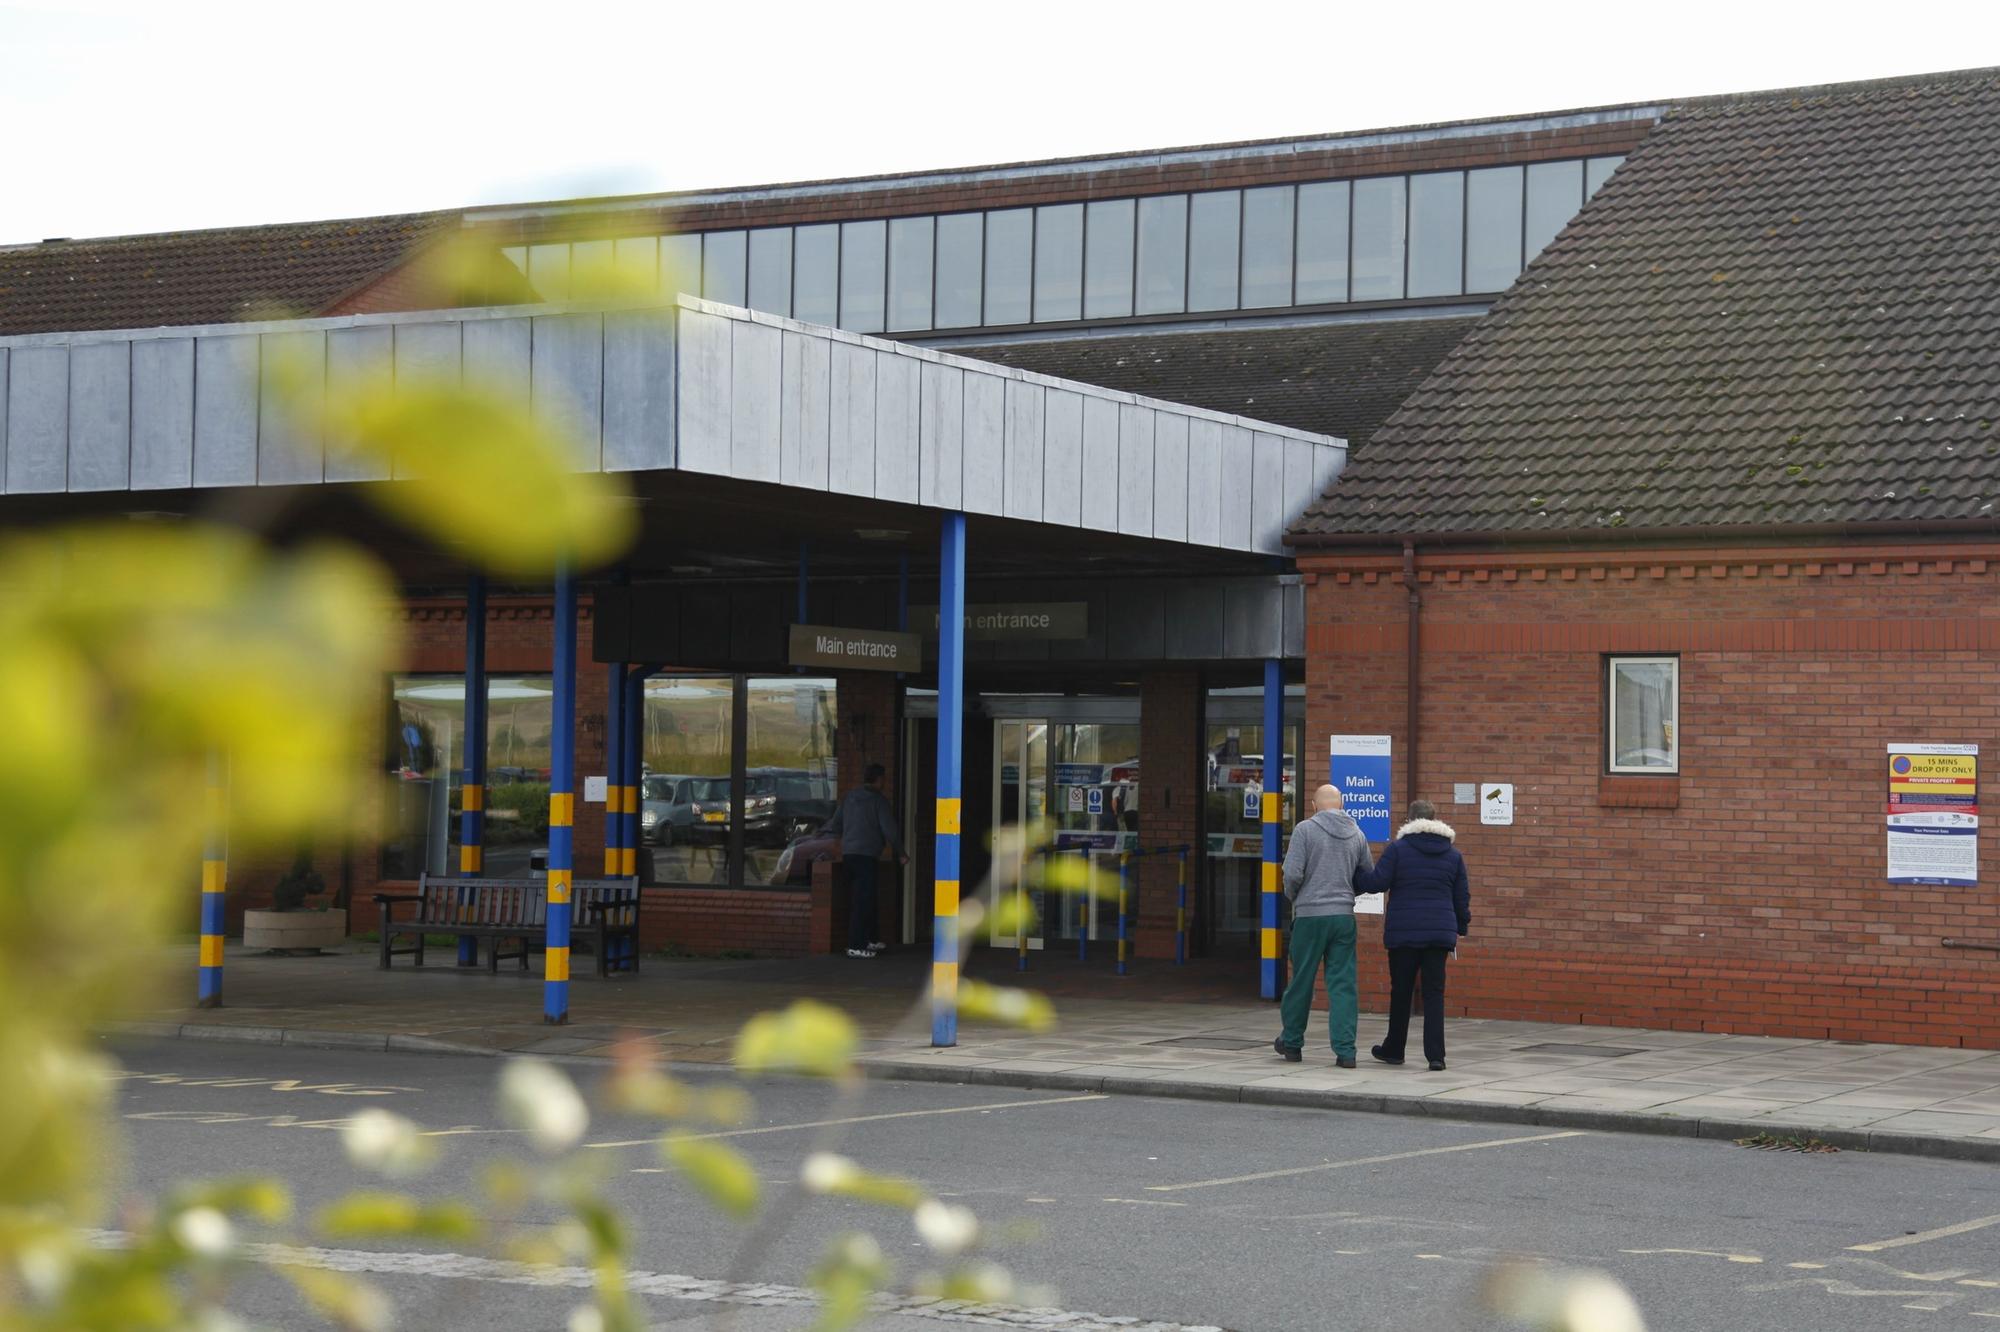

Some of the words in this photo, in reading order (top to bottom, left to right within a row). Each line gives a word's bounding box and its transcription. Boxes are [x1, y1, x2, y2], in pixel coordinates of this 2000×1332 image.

[976, 612, 1050, 628] entrance
[816, 635, 844, 655] Main
[846, 639, 897, 659] entrance
[1345, 775, 1375, 787] Main
[1341, 792, 1385, 803] ntrance
[1345, 806, 1389, 820] ception
